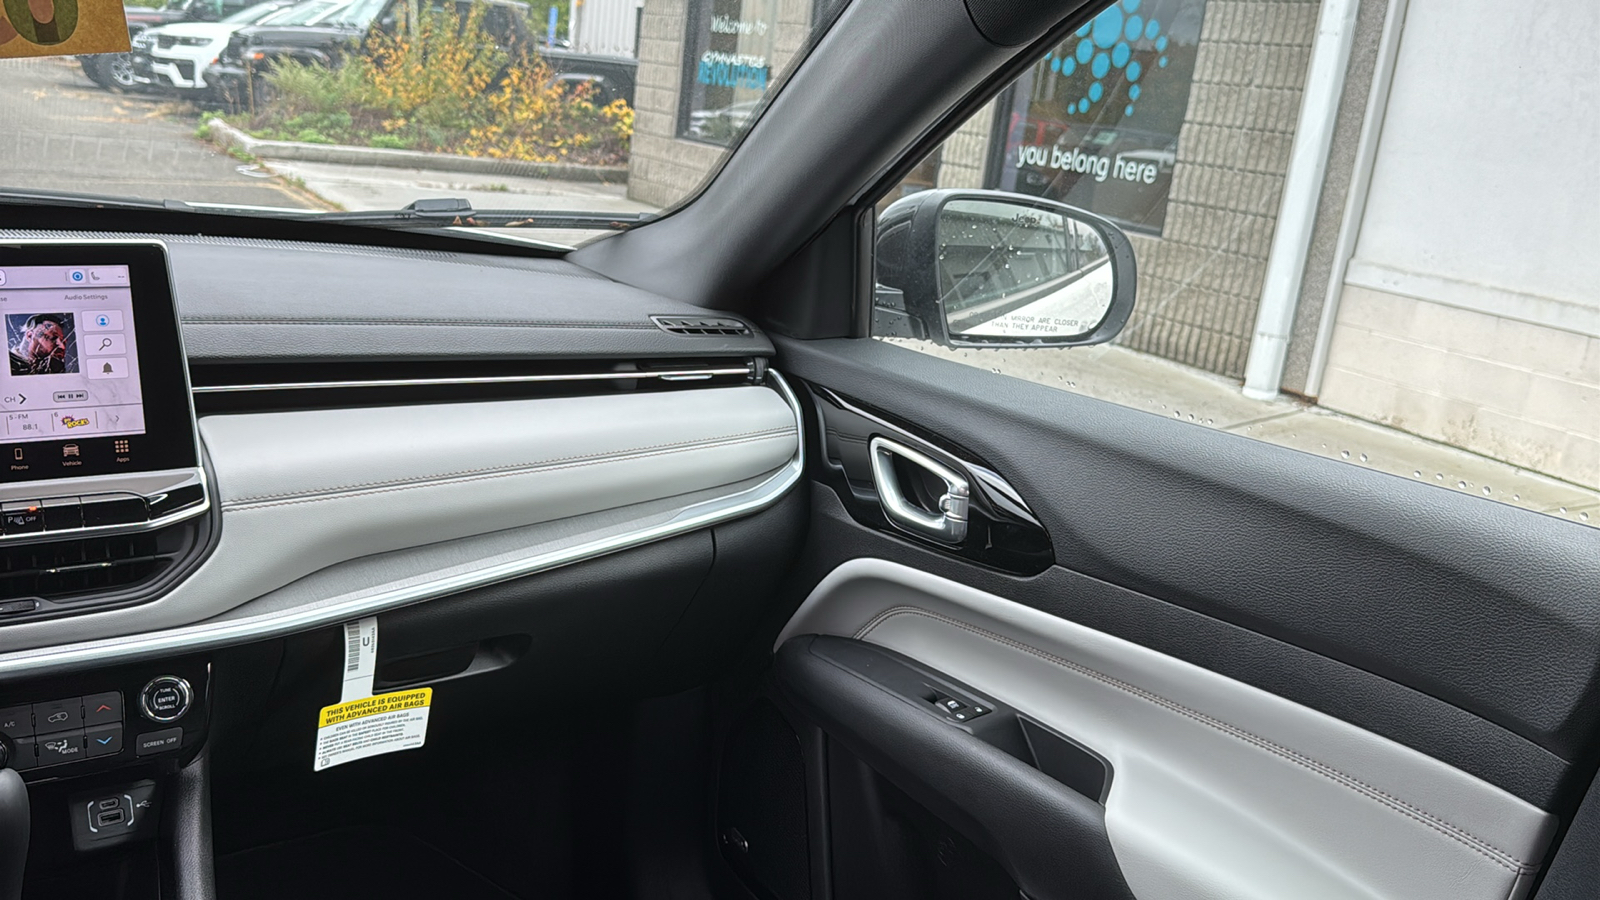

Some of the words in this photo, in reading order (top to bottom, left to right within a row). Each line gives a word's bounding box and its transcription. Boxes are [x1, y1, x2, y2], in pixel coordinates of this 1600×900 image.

[711, 14, 754, 34] Welcome
[1016, 144, 1048, 168] you
[1050, 144, 1110, 182] belong
[1112, 154, 1158, 184] here
[1012, 213, 1036, 224] Jeep
[83, 294, 108, 302] Settings
[1031, 324, 1058, 332] APPEAR
[362, 637, 370, 646] U
[326, 707, 343, 717] THIS
[345, 699, 377, 711] VEHICLE
[388, 692, 426, 703] EQUIPPED
[326, 714, 344, 724] WITH
[346, 705, 388, 718] ADVANCED
[404, 699, 424, 708] BAGS
[362, 717, 387, 725] ADVANCED
[143, 740, 164, 748] SCREEN
